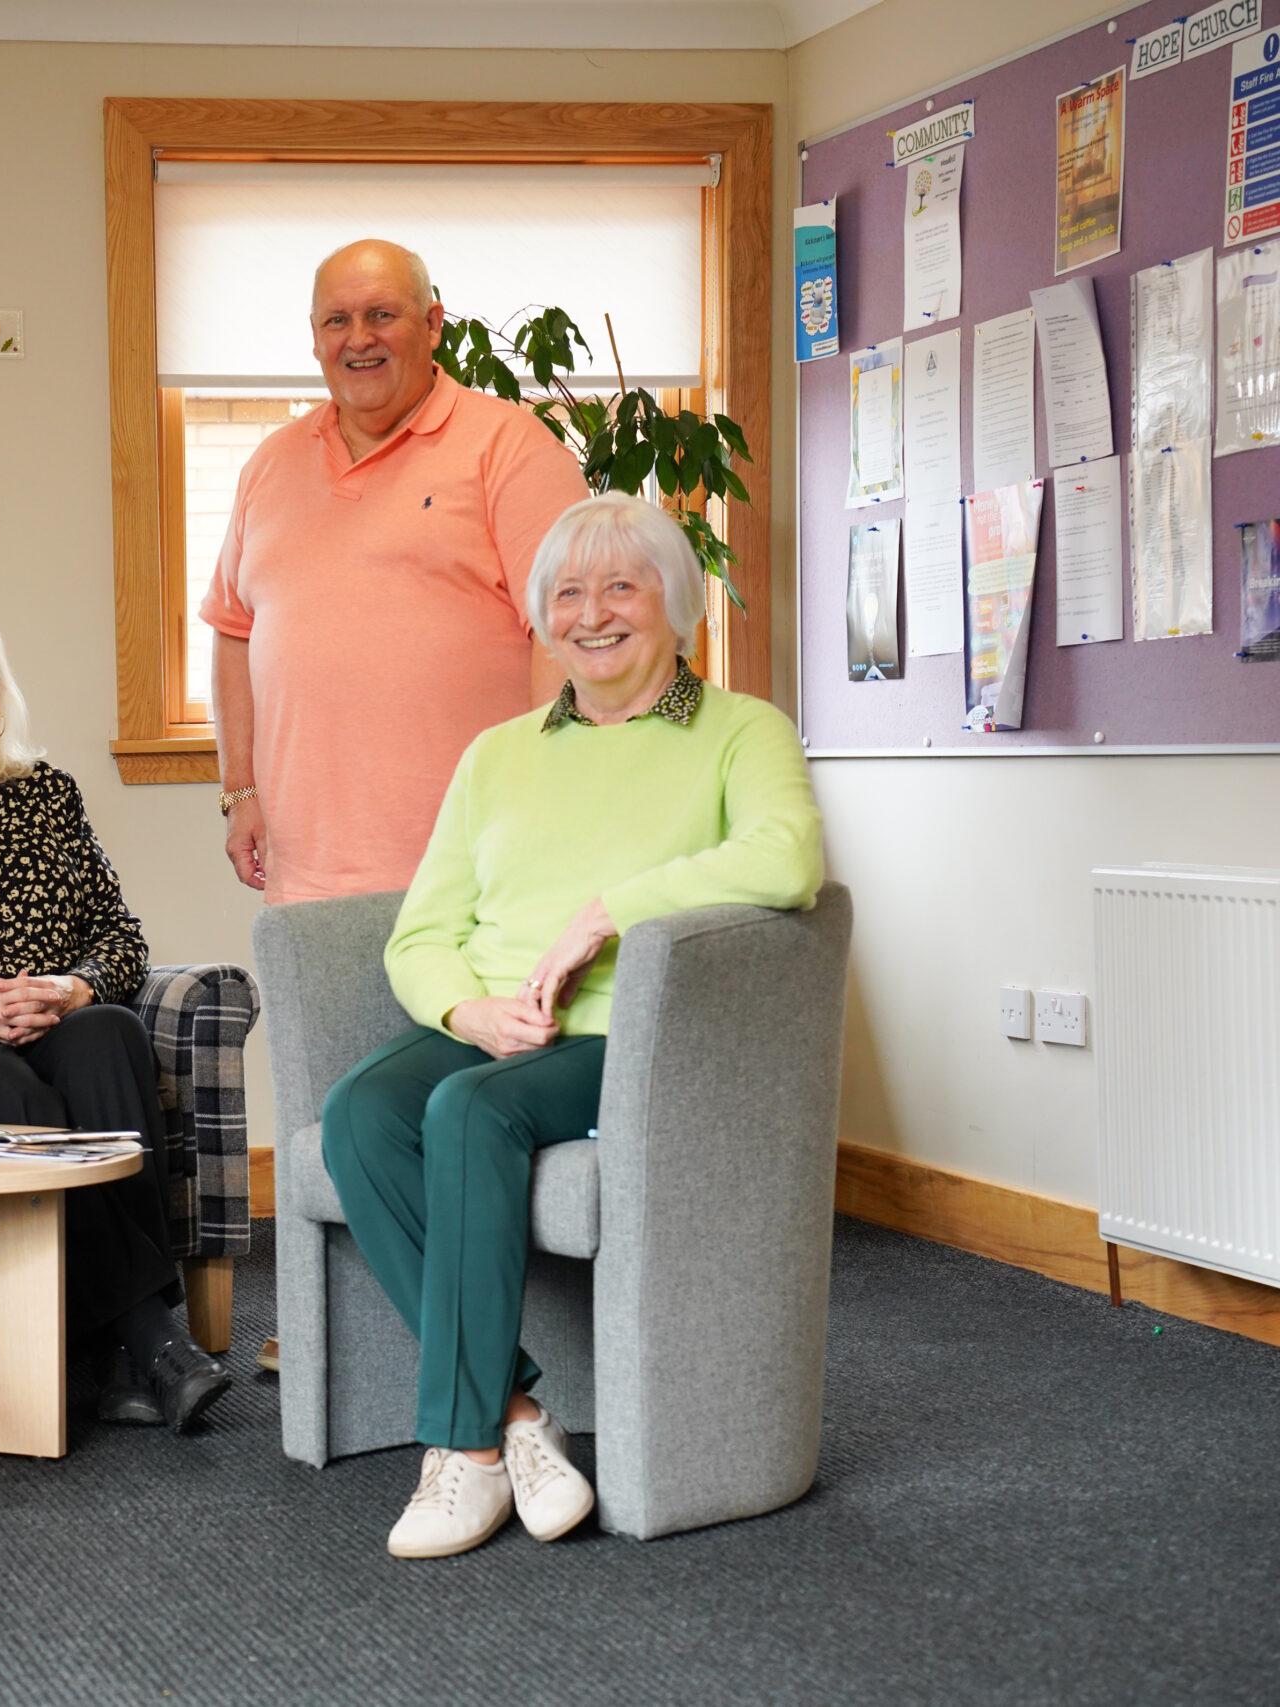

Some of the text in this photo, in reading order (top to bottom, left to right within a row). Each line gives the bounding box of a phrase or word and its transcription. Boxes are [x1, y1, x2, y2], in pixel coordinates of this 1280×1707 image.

[1137, 0, 1258, 68] HOPE CHURCH
[1061, 80, 1119, 116] A Warm Space
[1240, 77, 1258, 92] Staff
[1259, 72, 1274, 85] Fire
[897, 109, 970, 156] COMMUNITY
